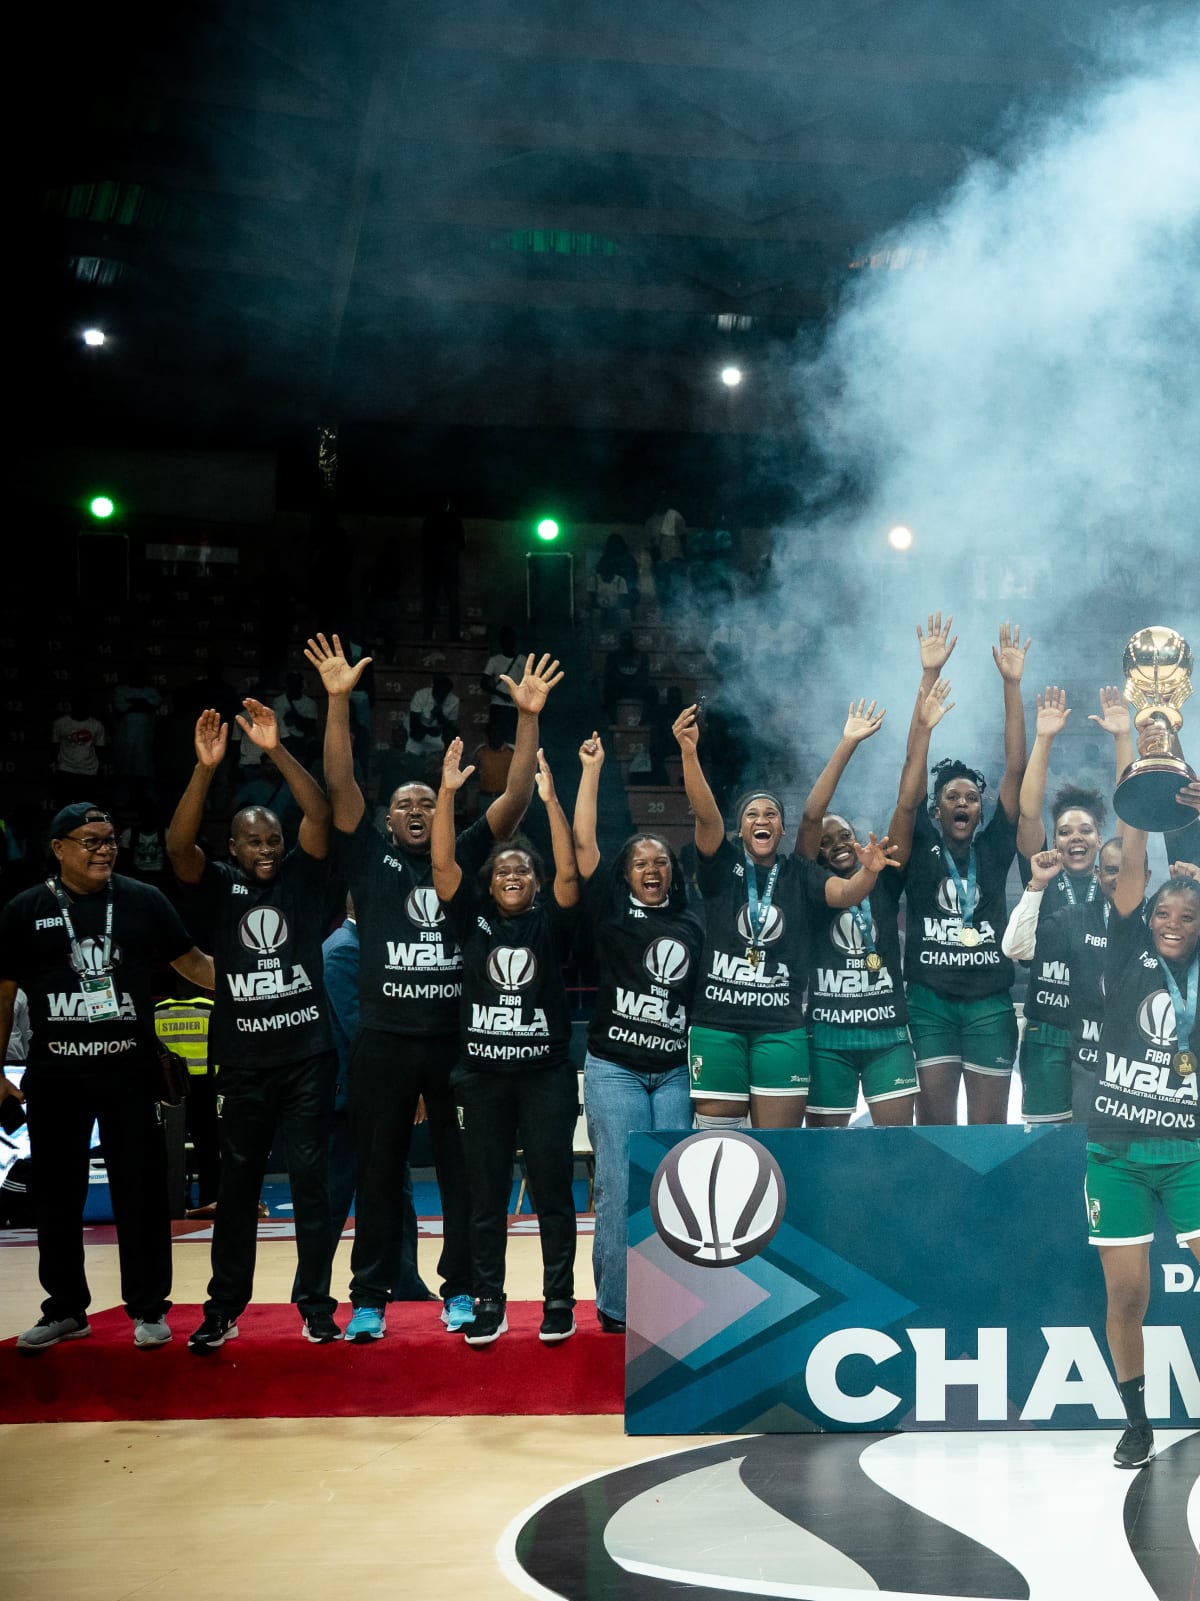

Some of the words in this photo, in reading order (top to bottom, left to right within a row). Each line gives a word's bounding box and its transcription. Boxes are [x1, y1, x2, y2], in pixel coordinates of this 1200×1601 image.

[733, 863, 745, 877] FIB
[231, 884, 249, 895] BA
[35, 916, 64, 931] FIBA
[923, 917, 996, 941] WBA
[420, 931, 442, 942] FIBA
[1084, 933, 1108, 948] FIBA
[386, 941, 464, 967] WBLA
[745, 947, 766, 961] FA
[920, 950, 1000, 966] CHAMPIONS
[1138, 951, 1159, 969] FIBA
[257, 958, 280, 970] FIBA
[712, 950, 790, 984] WBLA
[226, 964, 312, 997] WBLA
[816, 966, 893, 993] WBLA
[382, 982, 462, 999] CHAMPION
[650, 984, 669, 999] FIBA
[705, 985, 790, 1007] CHAMPIONS
[47, 992, 137, 1016] WA
[499, 994, 522, 1006] FIBA
[616, 986, 687, 1030] WBLA
[236, 1005, 320, 1033] CHAMPIONS
[472, 1003, 550, 1031] WBLA
[812, 1005, 896, 1024] CHAMPIONS
[162, 1021, 201, 1032] STADIER
[48, 1038, 137, 1056] CHAMPIONS
[608, 1026, 687, 1052] CHAMPIONS
[467, 1042, 550, 1060] CHAMPIONS
[1144, 1049, 1172, 1066] FIBA
[1105, 1051, 1199, 1101] WBLA
[1099, 1079, 1123, 1092] WOMEN'S
[1122, 1087, 1157, 1100] BASKETBALL
[1158, 1095, 1181, 1104] LEAGUE
[1181, 1098, 1198, 1106] AFRICA
[1094, 1095, 1196, 1129] CHAMPIONS
